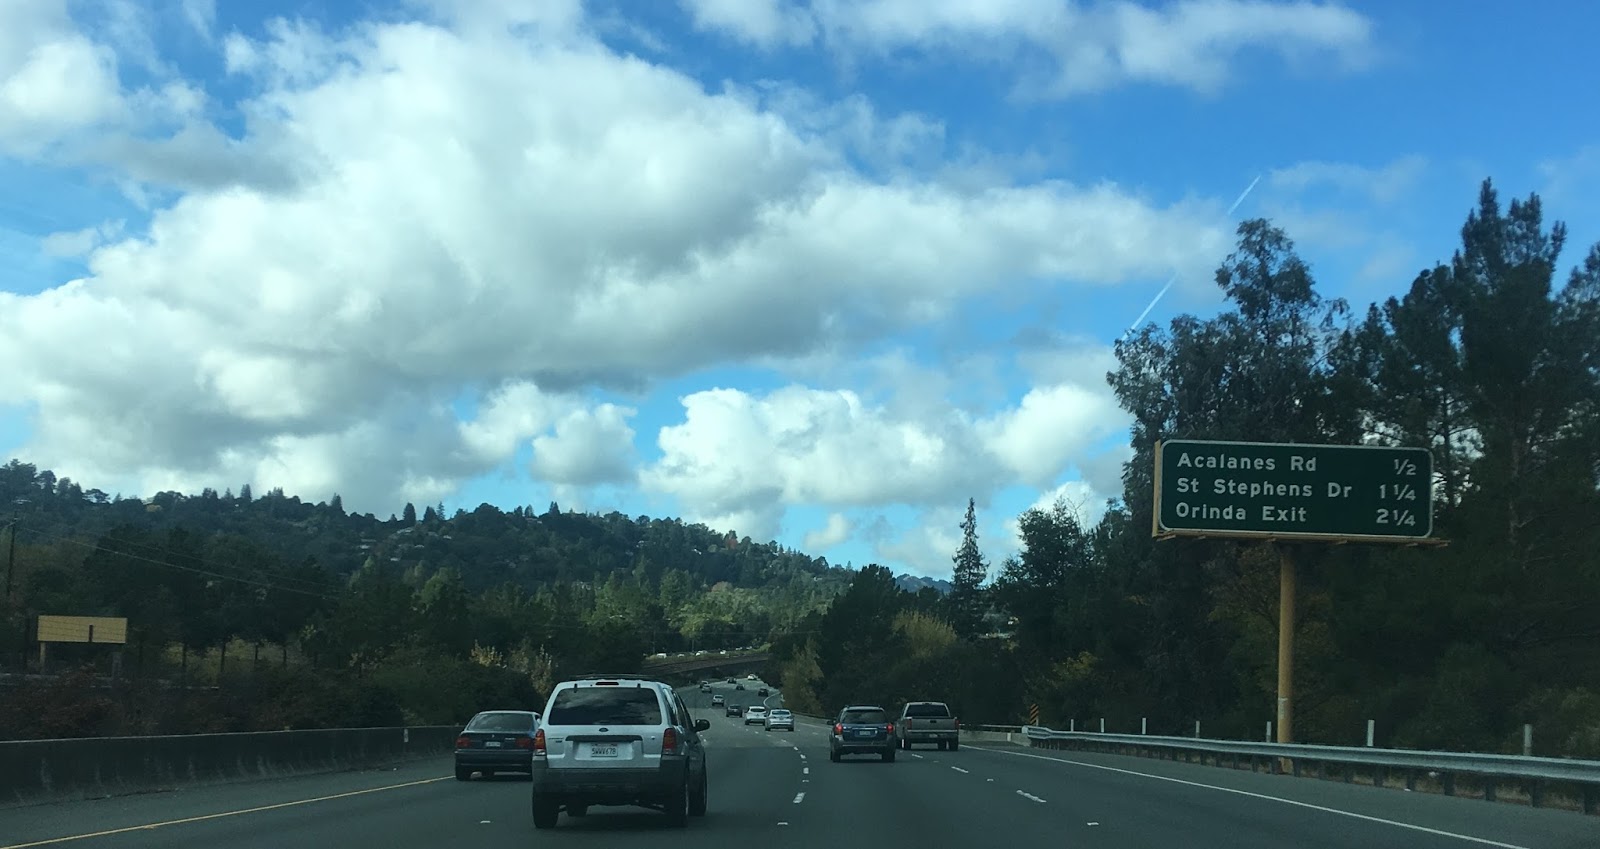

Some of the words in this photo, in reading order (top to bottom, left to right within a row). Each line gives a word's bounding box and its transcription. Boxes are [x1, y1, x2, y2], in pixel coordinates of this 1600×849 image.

[1176, 452, 1276, 471] Acalanes
[1290, 455, 1317, 472] Rd
[1176, 477, 1200, 493] St
[1213, 478, 1313, 498] Stephens
[1327, 482, 1353, 498] Dr
[1175, 502, 1246, 521] Orinda
[1262, 505, 1307, 522] Exit
